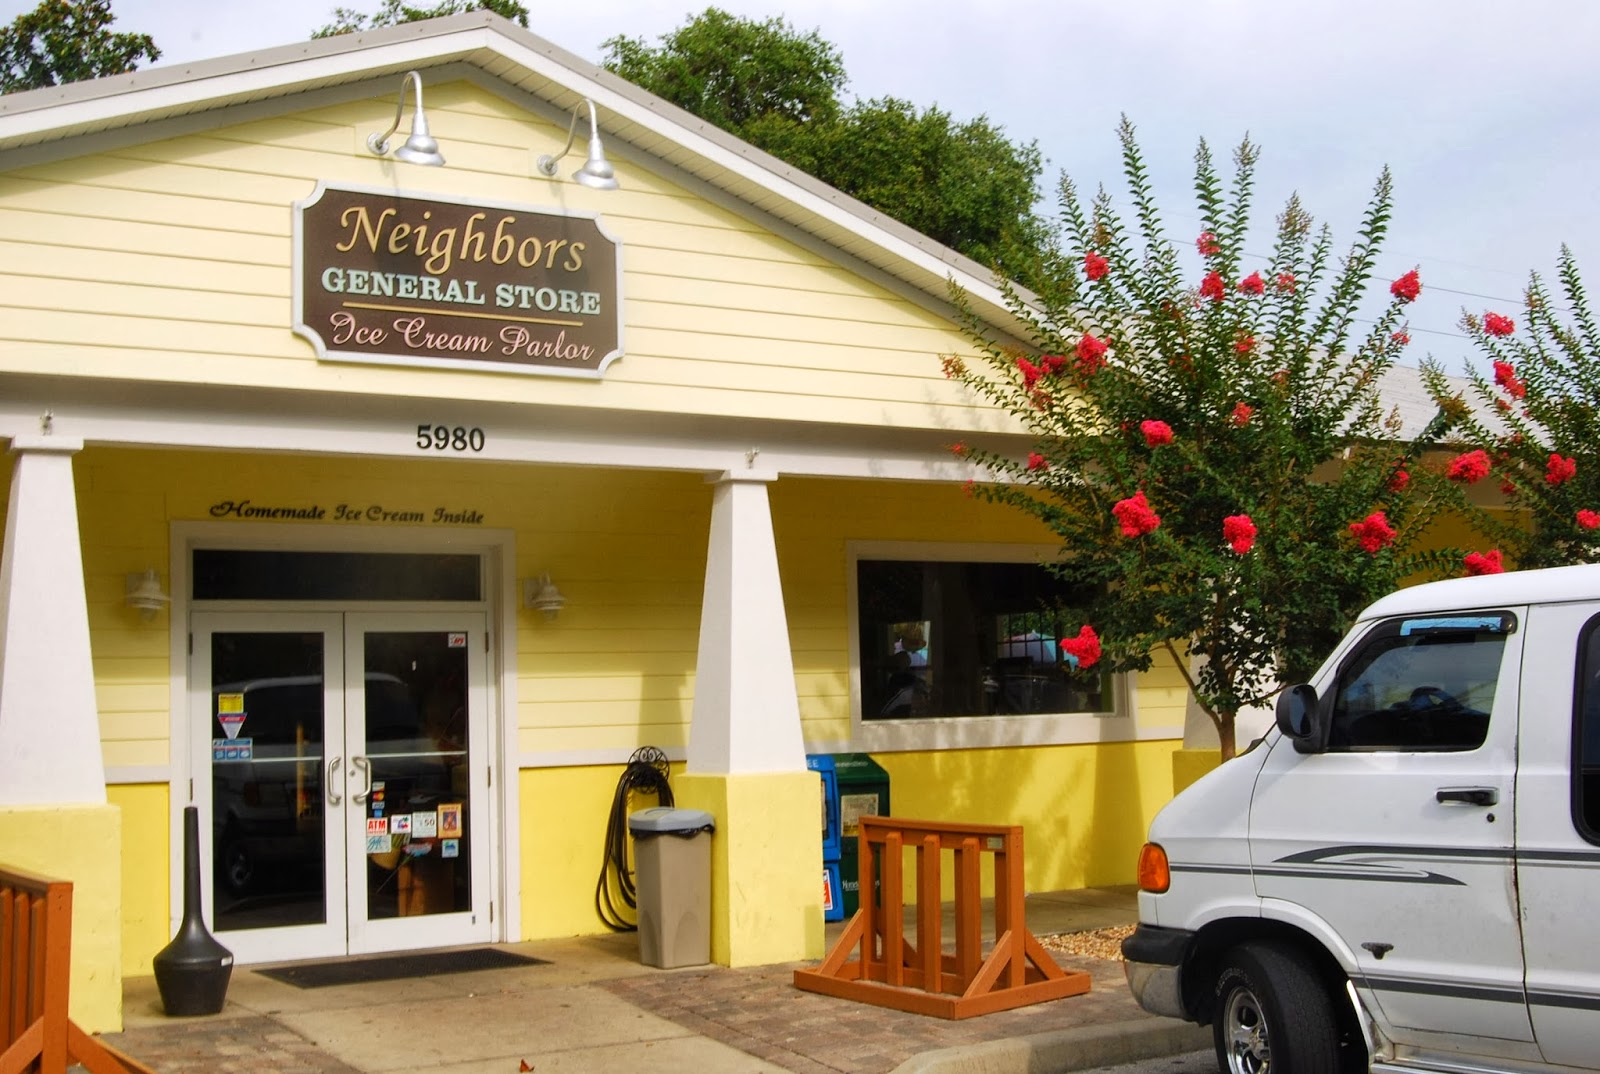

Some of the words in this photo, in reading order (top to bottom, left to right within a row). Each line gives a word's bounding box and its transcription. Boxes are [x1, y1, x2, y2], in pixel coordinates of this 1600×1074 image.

[335, 206, 586, 275] Neighbors
[321, 266, 485, 304] GENERAL
[495, 283, 601, 315] STORE
[329, 311, 388, 345] Ice
[393, 312, 493, 353] Cream
[500, 325, 595, 361] Parlor
[416, 424, 485, 451] 5980
[209, 500, 326, 520] Homemade
[333, 504, 362, 521] Ice
[366, 505, 424, 522] Cream
[432, 507, 484, 524] Inside
[368, 820, 386, 830] ATM
